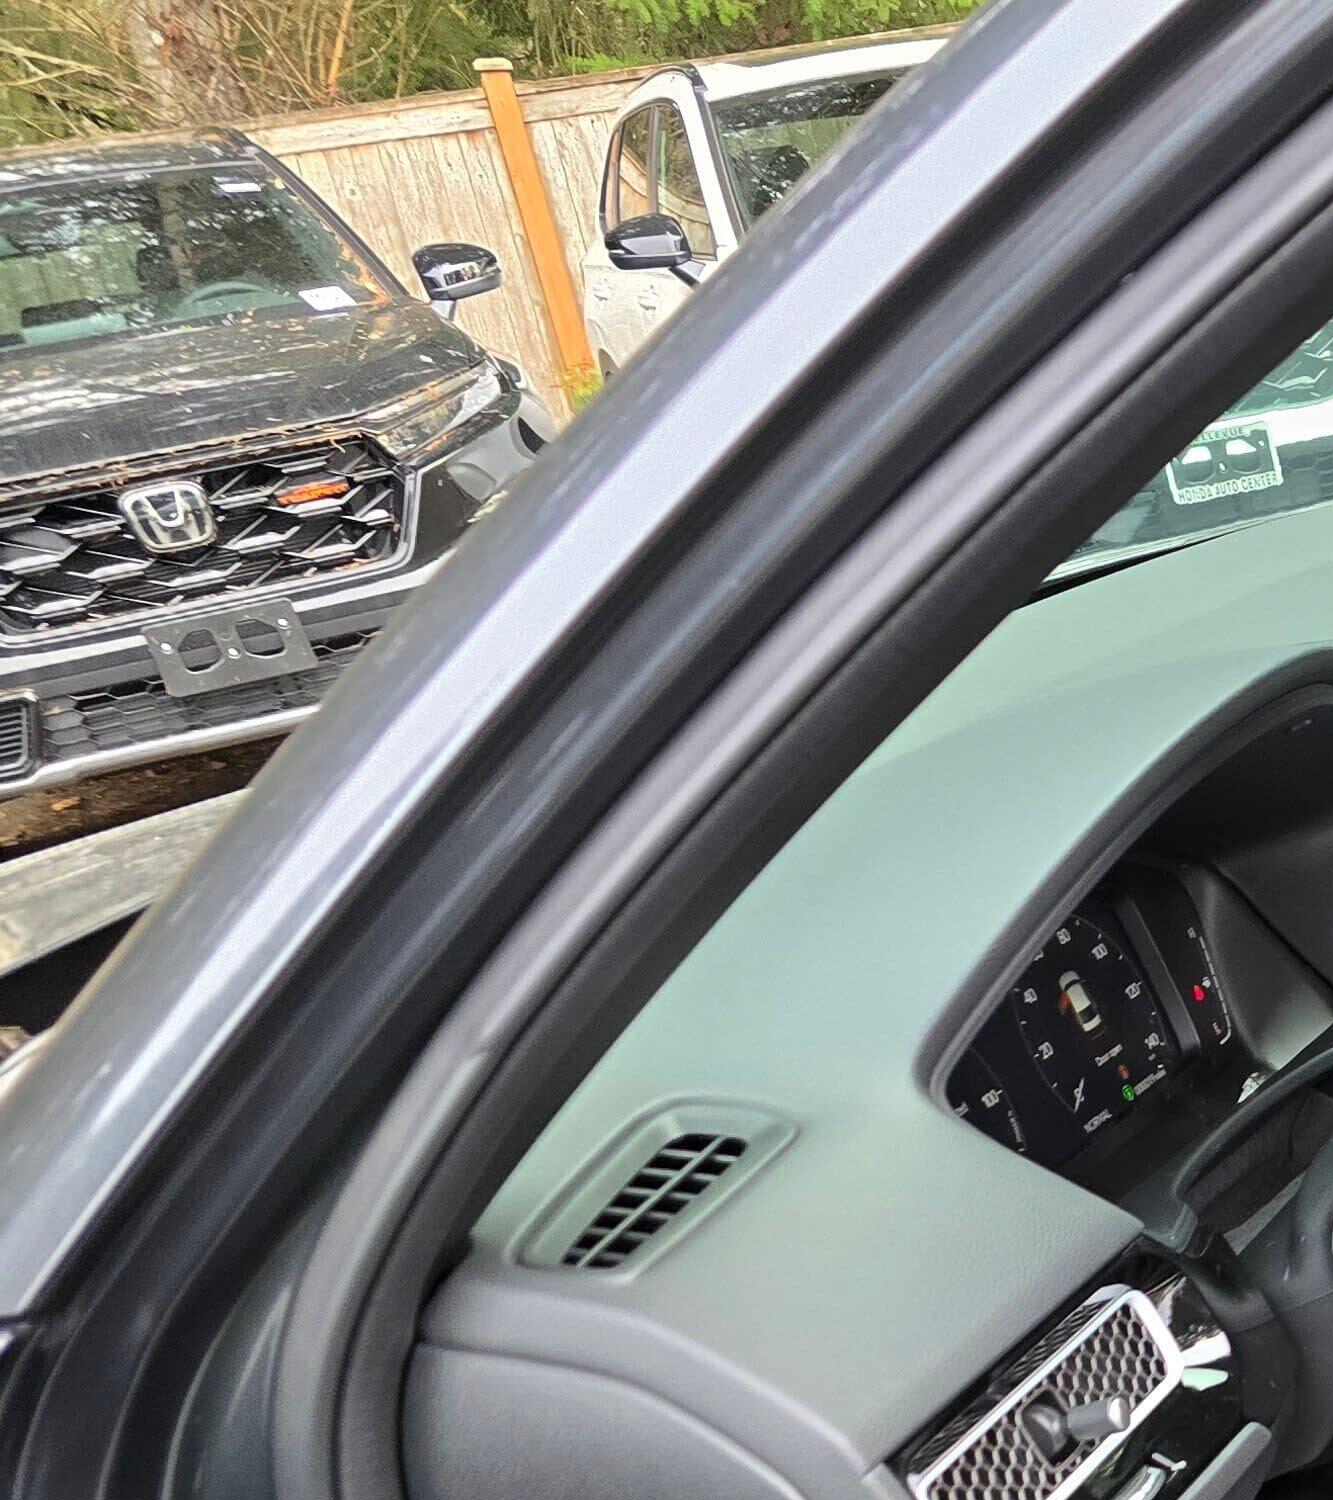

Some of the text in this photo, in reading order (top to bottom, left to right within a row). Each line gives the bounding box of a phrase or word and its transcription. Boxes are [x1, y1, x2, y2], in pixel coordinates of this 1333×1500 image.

[1200, 426, 1244, 441] LLEVUE
[1178, 472, 1279, 503] HONDA AUTO CENTER
